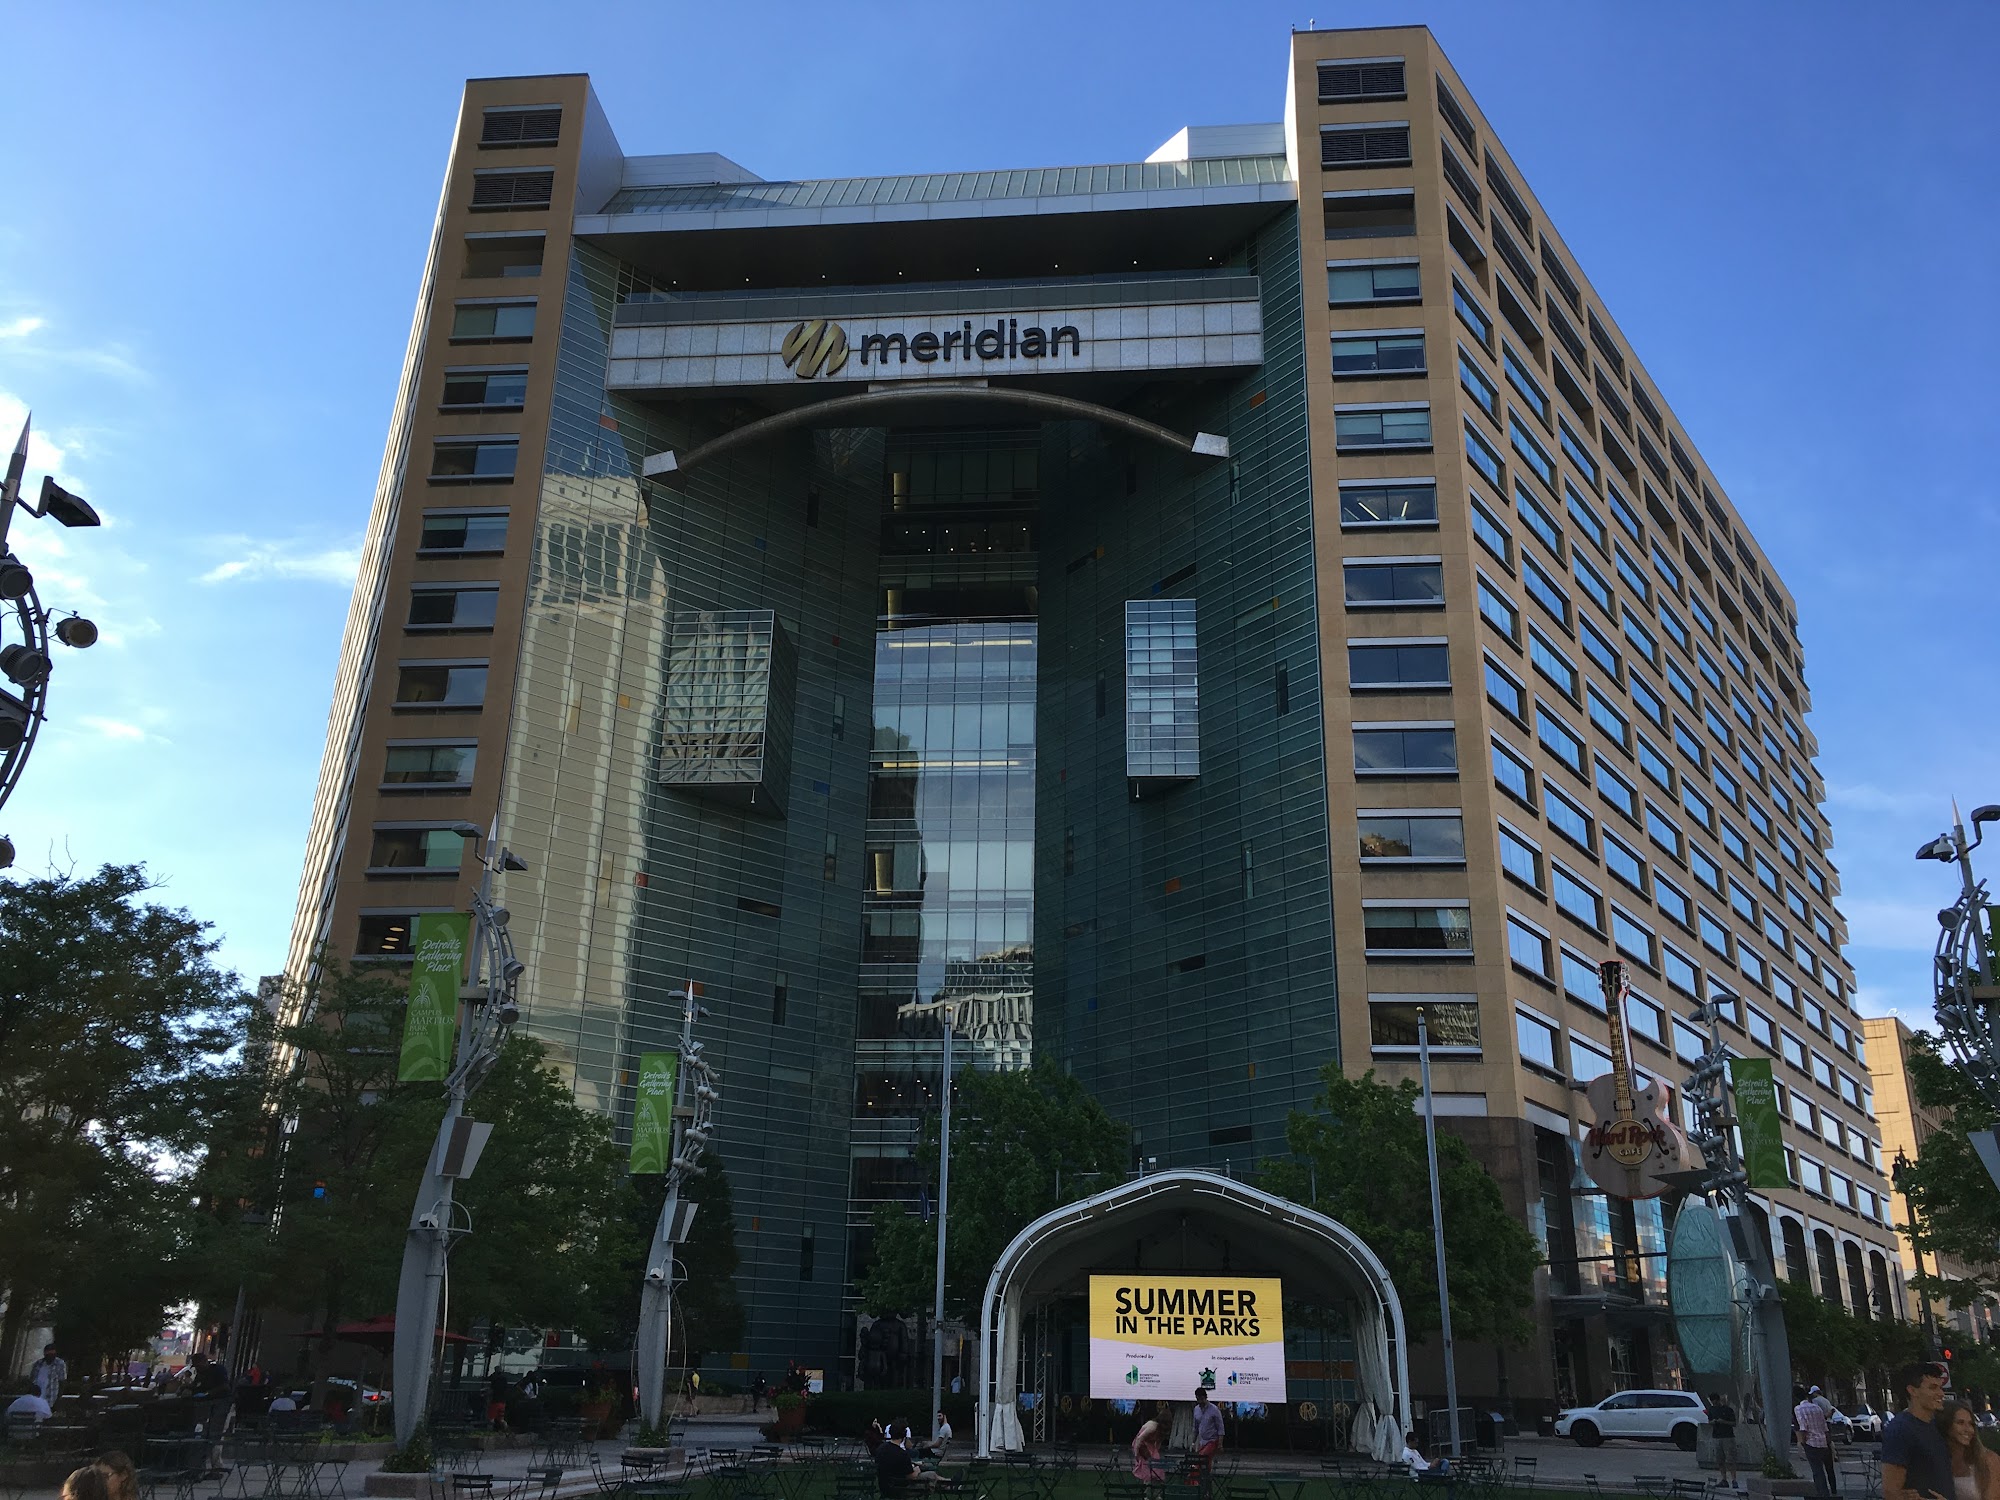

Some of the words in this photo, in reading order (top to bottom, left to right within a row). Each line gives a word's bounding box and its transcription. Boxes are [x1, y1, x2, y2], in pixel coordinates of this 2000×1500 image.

[860, 318, 1080, 365] meridian
[421, 938, 461, 950] Detroit's
[416, 950, 463, 965] Gathering
[425, 960, 452, 972] Place
[410, 1016, 455, 1025] MARTIUS
[639, 1079, 673, 1090] Gathering
[1737, 1078, 1769, 1088] Detroit's
[646, 1087, 666, 1096] Place
[1735, 1087, 1773, 1100] Gathering
[1746, 1095, 1766, 1105] Place
[1589, 1127, 1626, 1146] Hard
[1628, 1124, 1666, 1148] Rock
[1619, 1147, 1642, 1156] CAFE
[1115, 1287, 1258, 1317] SUMMER
[1115, 1315, 1138, 1334] IN
[1144, 1316, 1185, 1335] THE
[1192, 1317, 1261, 1337] PARKS
